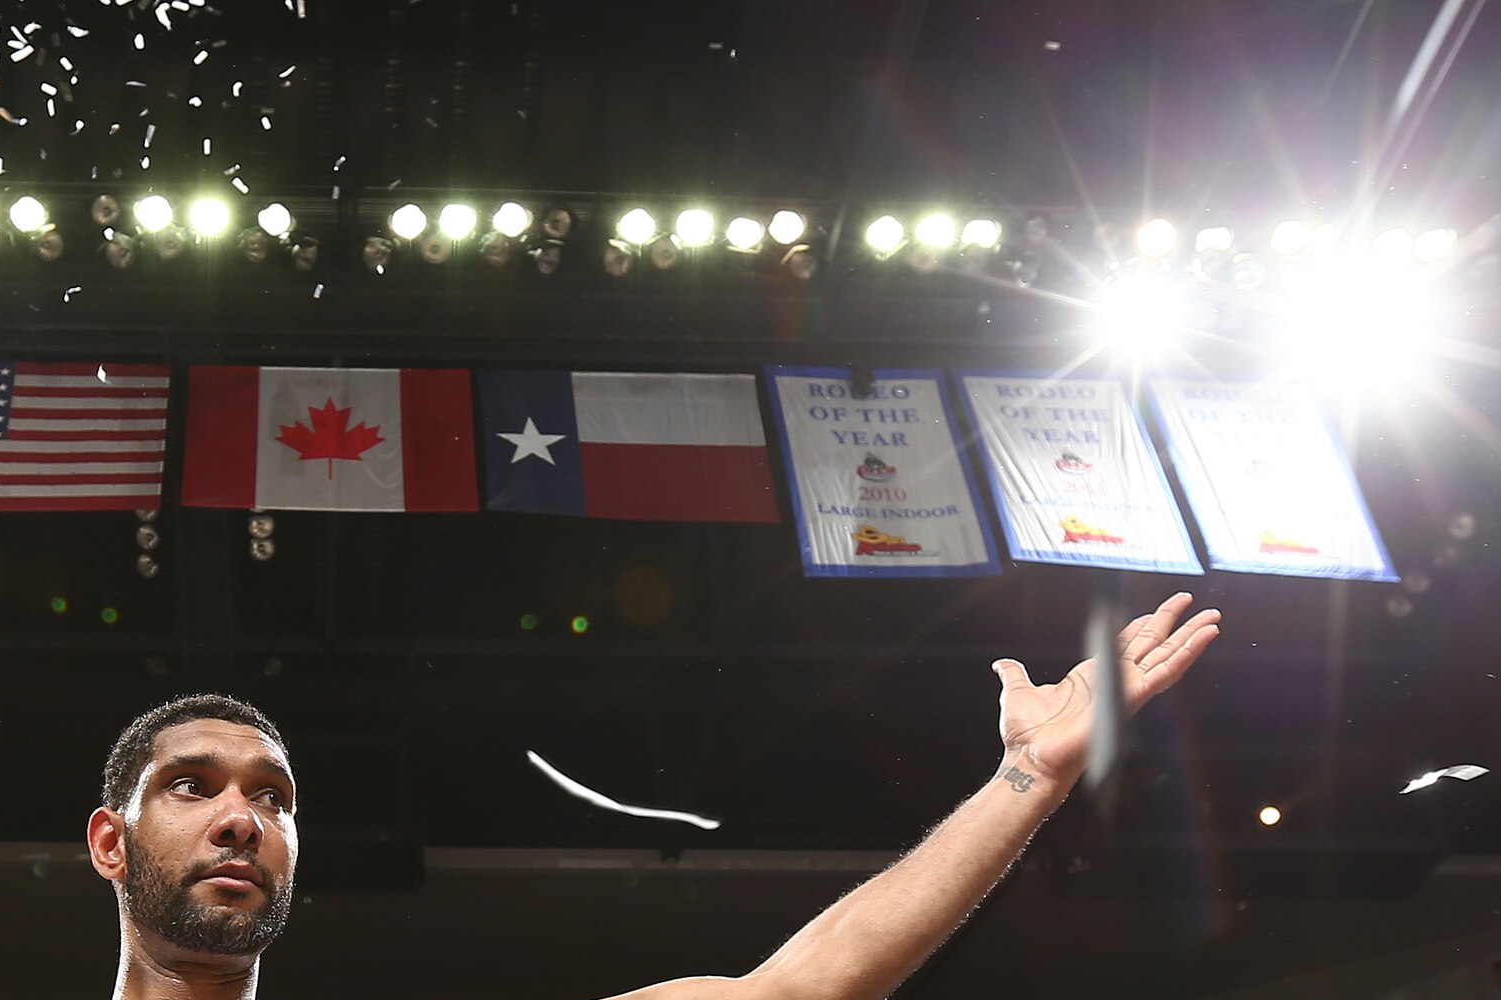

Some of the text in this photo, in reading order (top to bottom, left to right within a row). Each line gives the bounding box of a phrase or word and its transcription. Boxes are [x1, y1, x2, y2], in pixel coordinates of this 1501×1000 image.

[808, 406, 921, 424] OF THE
[999, 405, 1111, 422] OF THE
[830, 431, 910, 447] YEAR
[1021, 427, 1100, 443] YEAR
[858, 485, 908, 501] 2010
[817, 502, 960, 520] LARGE INDOOR
